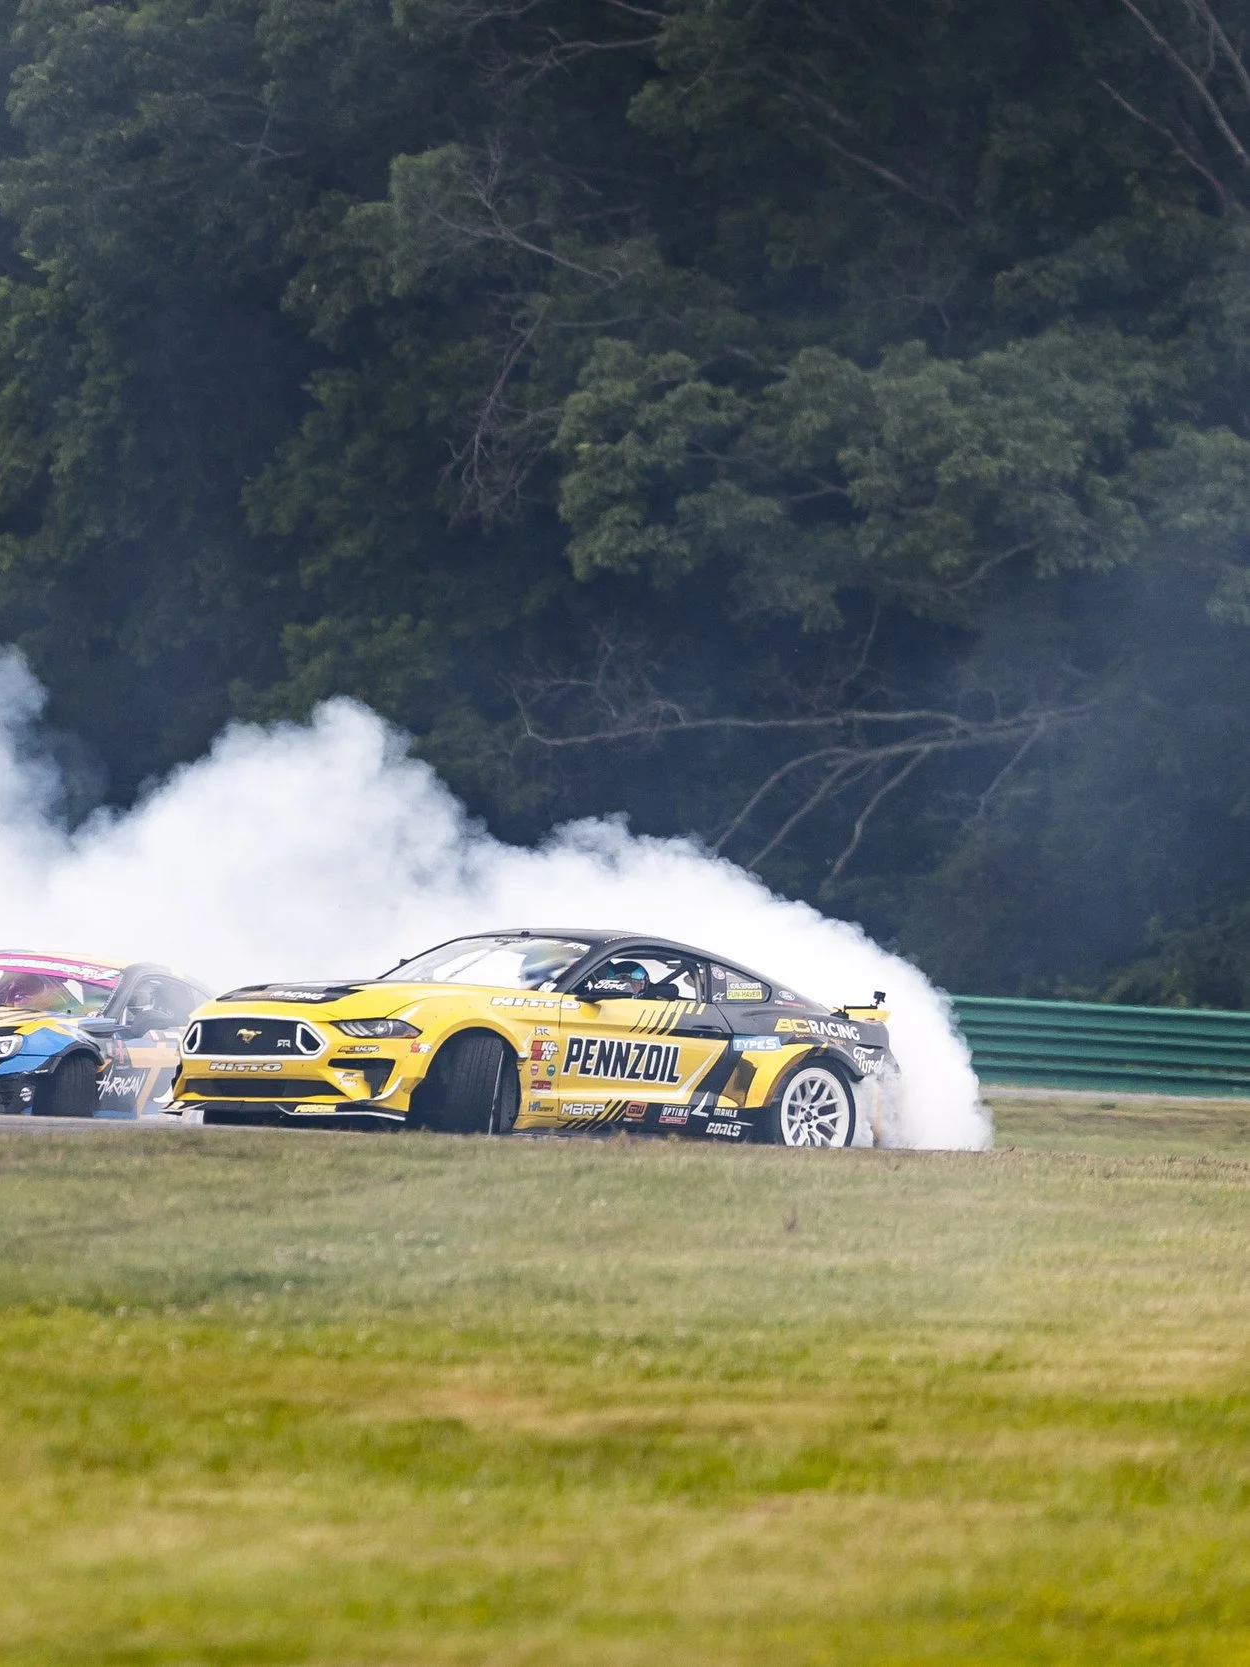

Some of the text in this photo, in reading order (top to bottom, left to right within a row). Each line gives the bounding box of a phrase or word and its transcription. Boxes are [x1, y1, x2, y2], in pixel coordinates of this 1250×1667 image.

[594, 979, 630, 991] Ford
[490, 997, 581, 1010] NITTO
[808, 1020, 861, 1041] RACING
[209, 1061, 283, 1072] NITTO
[562, 1036, 682, 1084] PENNZOIL
[853, 1046, 885, 1074] Ford
[561, 1103, 606, 1116] MBRP
[661, 1106, 689, 1118] OPTIMA
[713, 1107, 738, 1119] MAHLE
